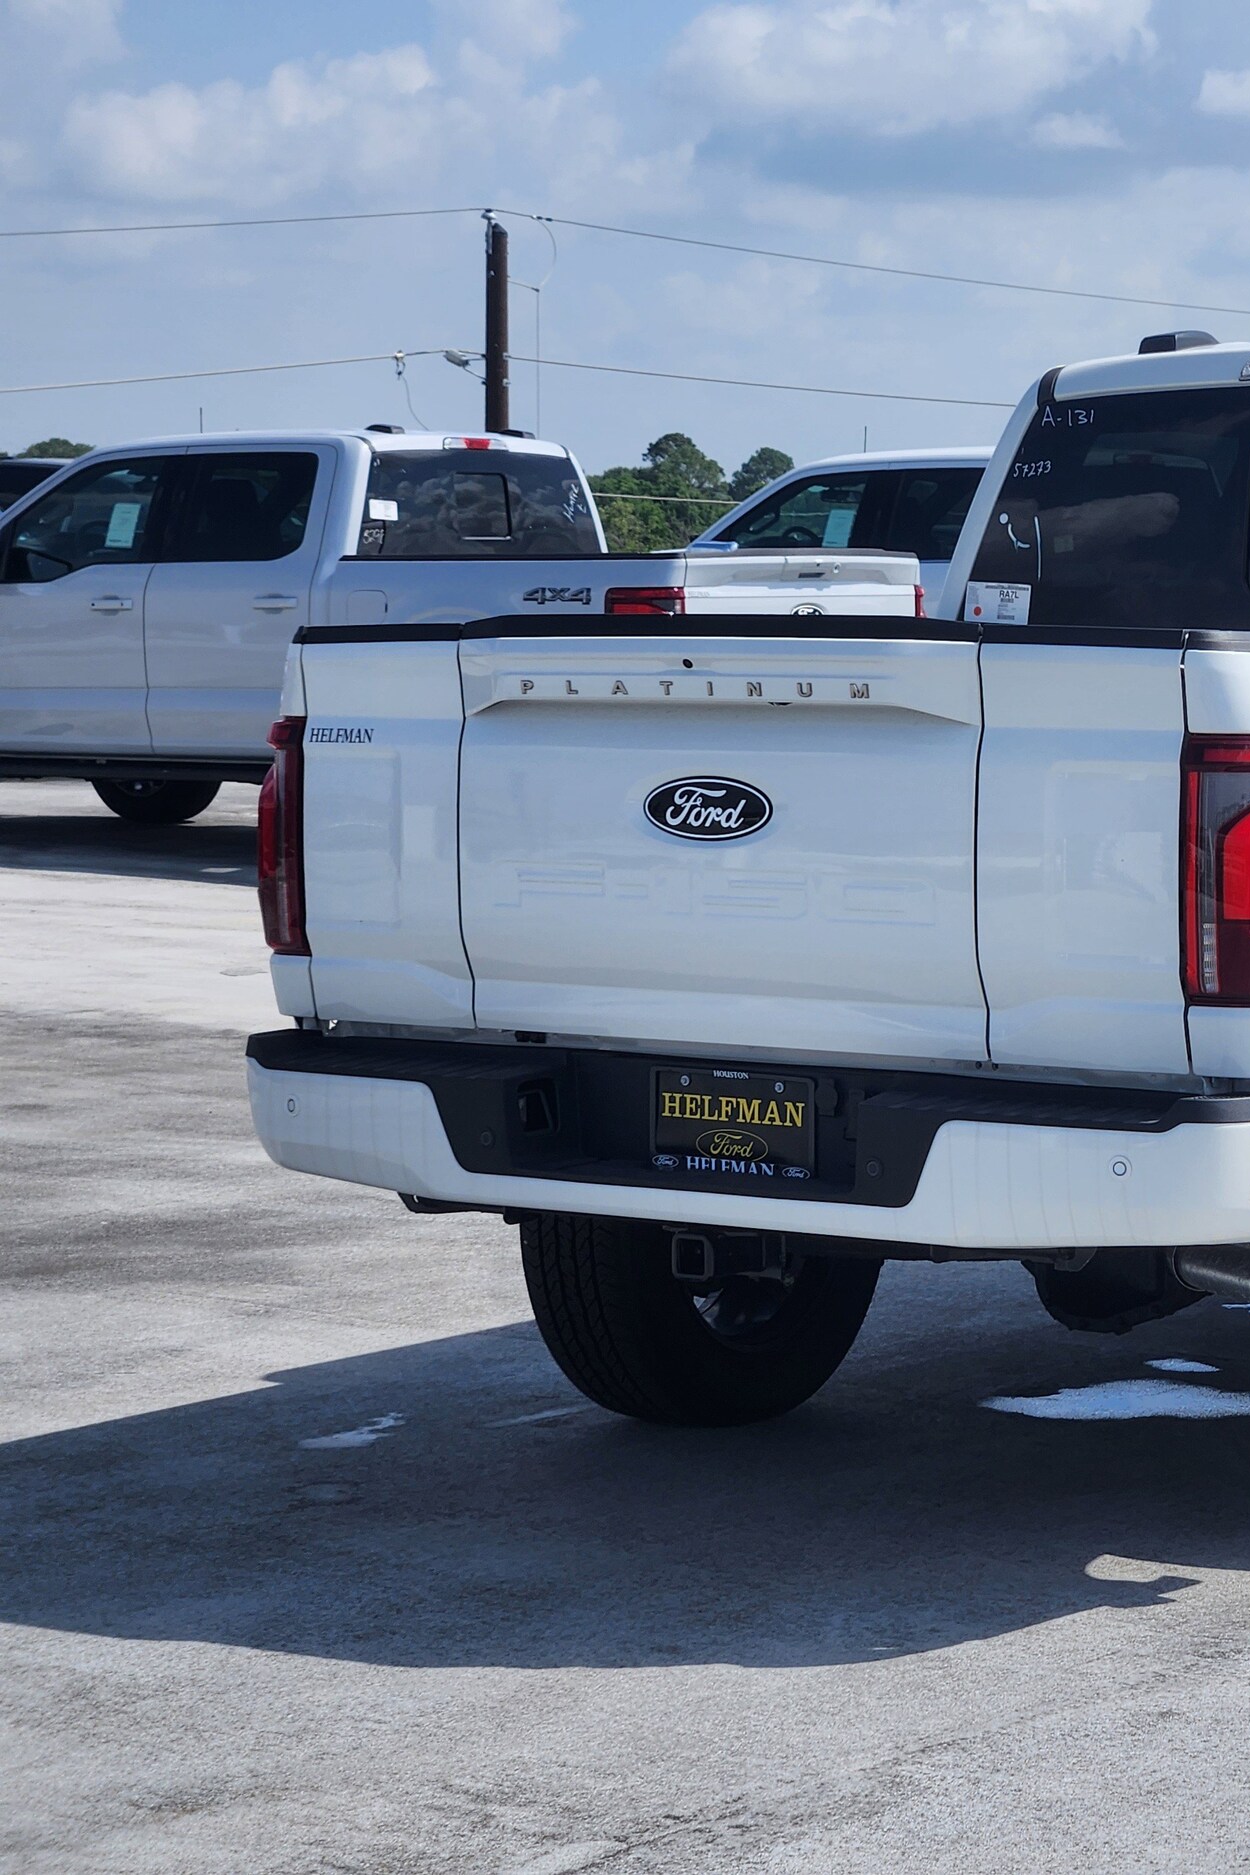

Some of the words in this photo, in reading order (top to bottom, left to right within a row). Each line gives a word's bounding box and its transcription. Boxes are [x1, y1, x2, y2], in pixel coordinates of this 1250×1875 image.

[1041, 405, 1095, 427] A-131
[998, 590, 1019, 599] RA7L
[520, 679, 870, 699] PLATINUM
[309, 727, 375, 743] HELFMAN
[665, 786, 747, 829] Ford
[492, 859, 936, 926] F-150
[713, 1070, 749, 1079] HOUSTON
[662, 1092, 805, 1127] HELFMAN
[710, 1132, 754, 1158] Ford
